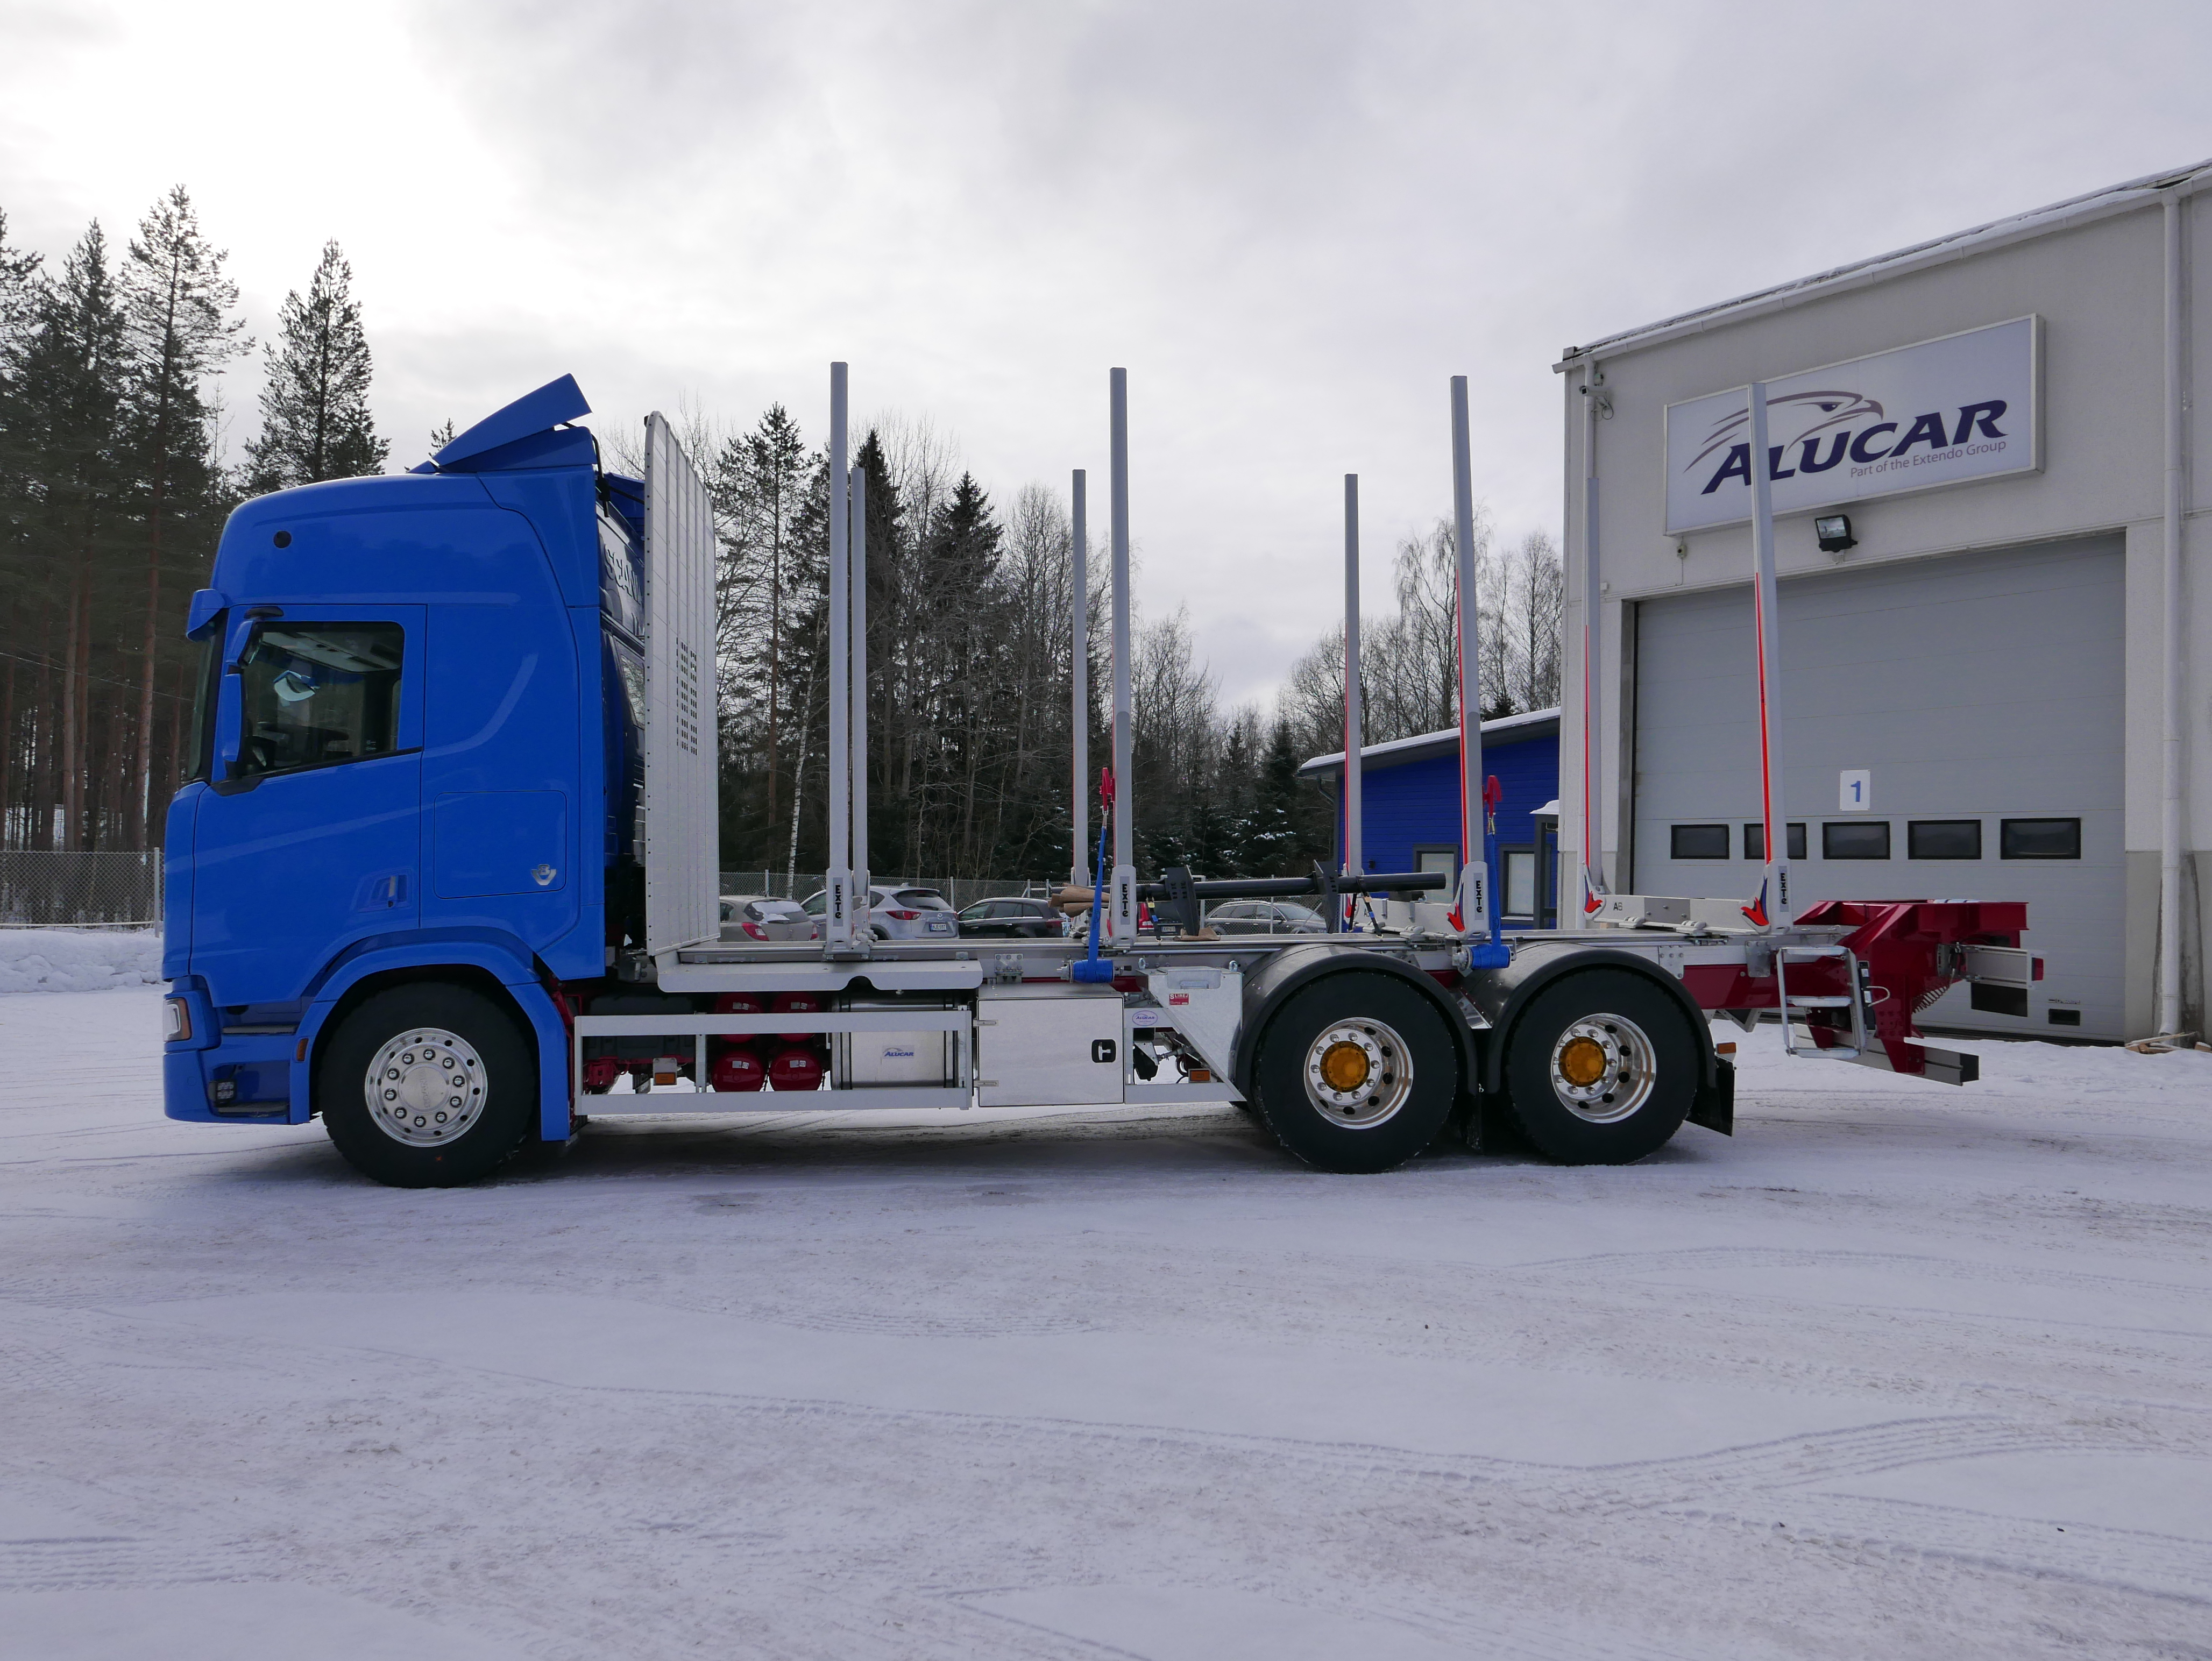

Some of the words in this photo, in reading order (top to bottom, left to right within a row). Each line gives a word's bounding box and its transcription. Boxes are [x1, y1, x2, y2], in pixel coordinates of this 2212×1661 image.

[1700, 400, 2008, 495] ALUCAR
[1851, 466, 1873, 478] Part
[1876, 462, 1888, 473] of
[1890, 459, 1910, 470] the
[1913, 448, 1963, 466] Extendo
[1966, 441, 2007, 456] Group
[1851, 780, 1861, 802] 1
